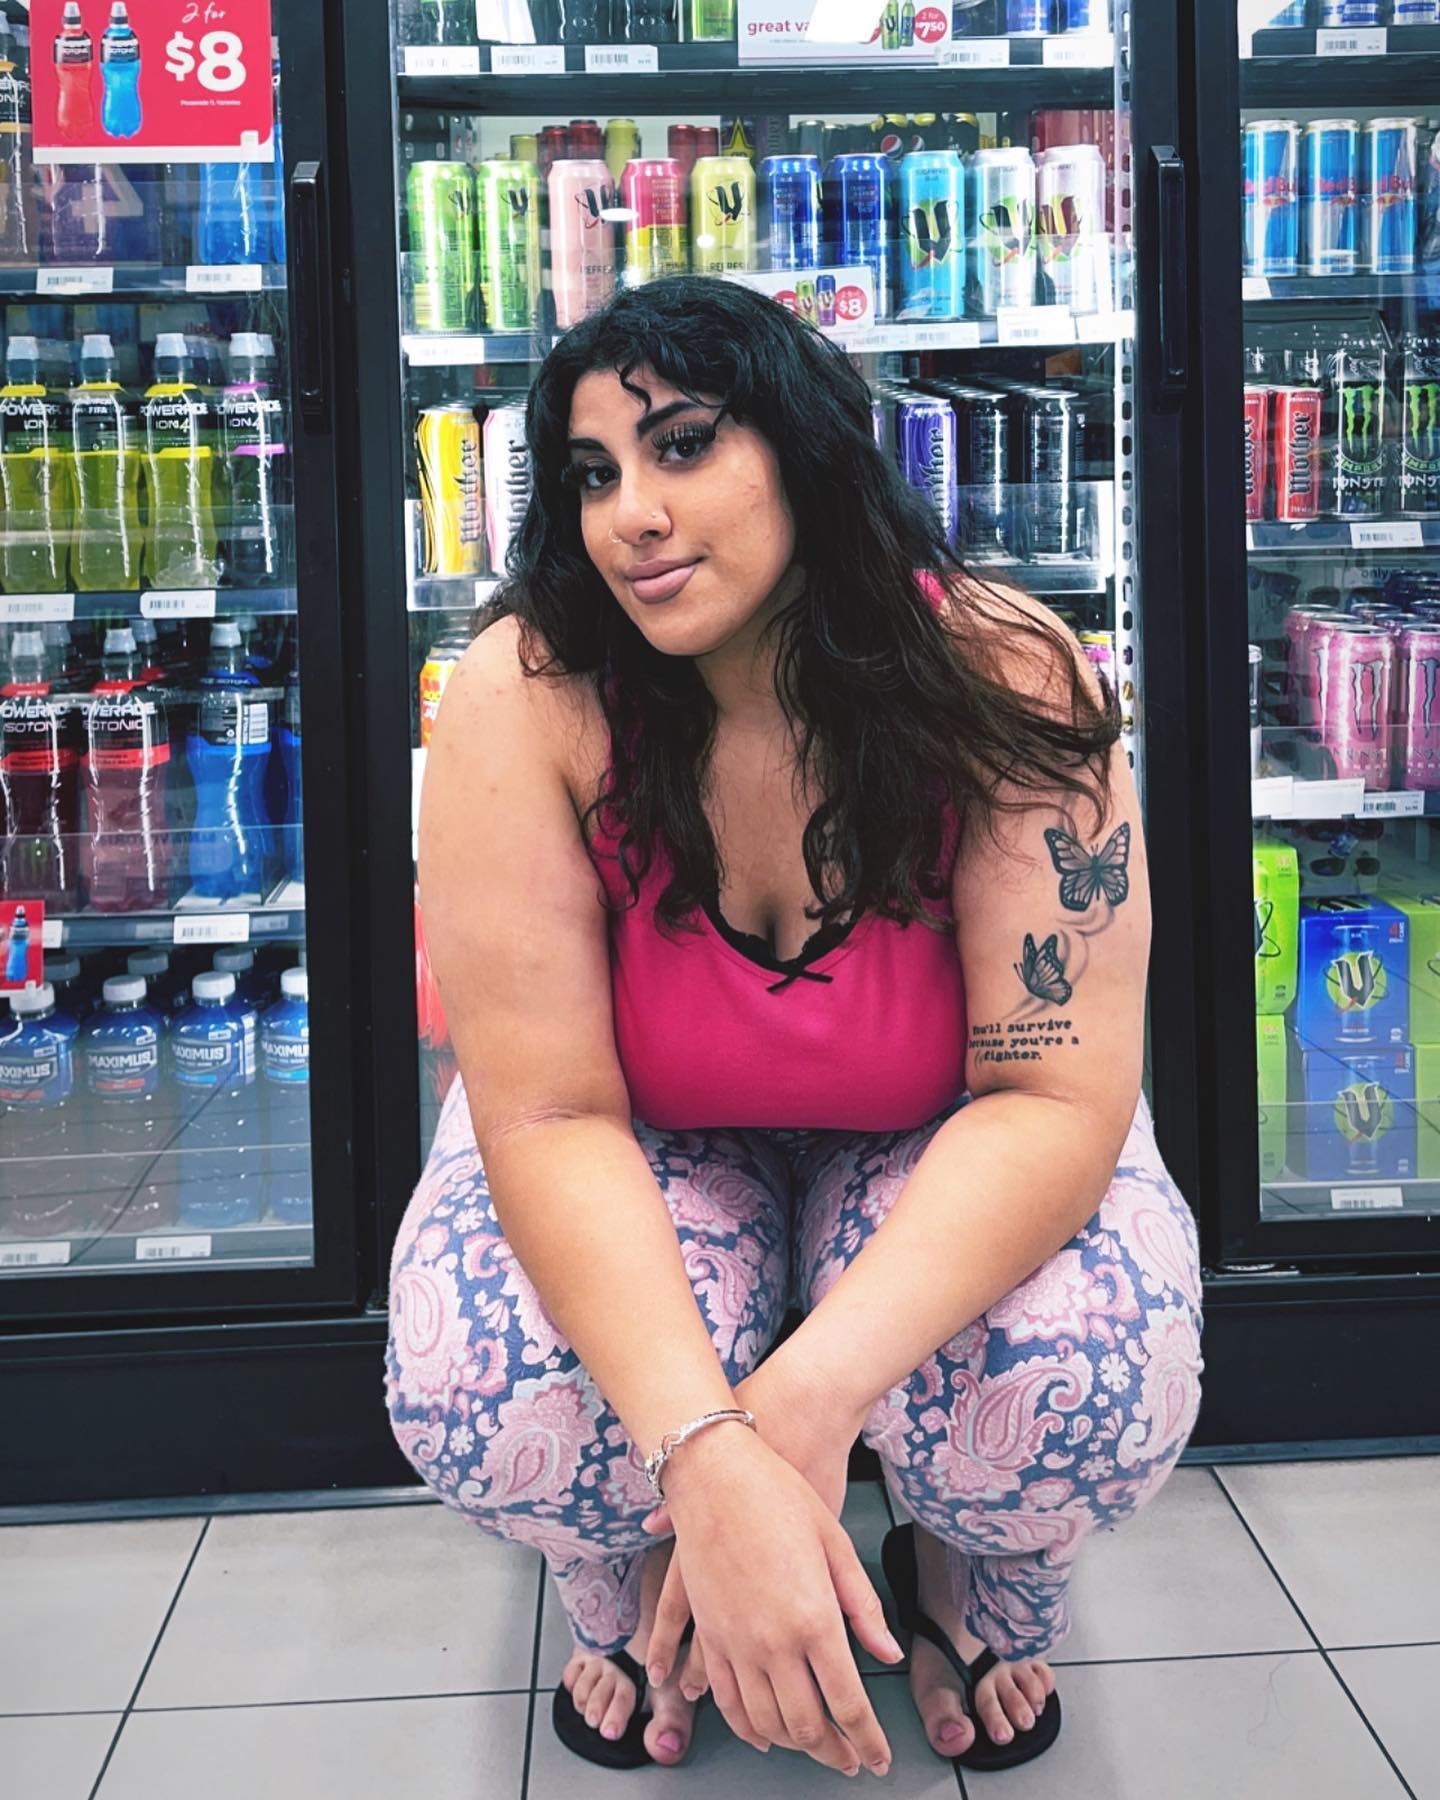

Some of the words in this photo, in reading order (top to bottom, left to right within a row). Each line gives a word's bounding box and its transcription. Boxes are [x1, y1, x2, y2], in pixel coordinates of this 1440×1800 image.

[181, 2, 199, 24] 2
[204, 1, 226, 24] for
[747, 20, 791, 36] great
[164, 30, 247, 93] $8
[1007, 1019, 1072, 1034] survive
[261, 1040, 309, 1058] MAXIMU
[1010, 1035, 1063, 1049] you're
[1071, 1035, 1080, 1045] a
[88, 1050, 151, 1069] MAXIMUS
[983, 1049, 1042, 1063] fighter.
[0, 1062, 51, 1079] AXIMUS
